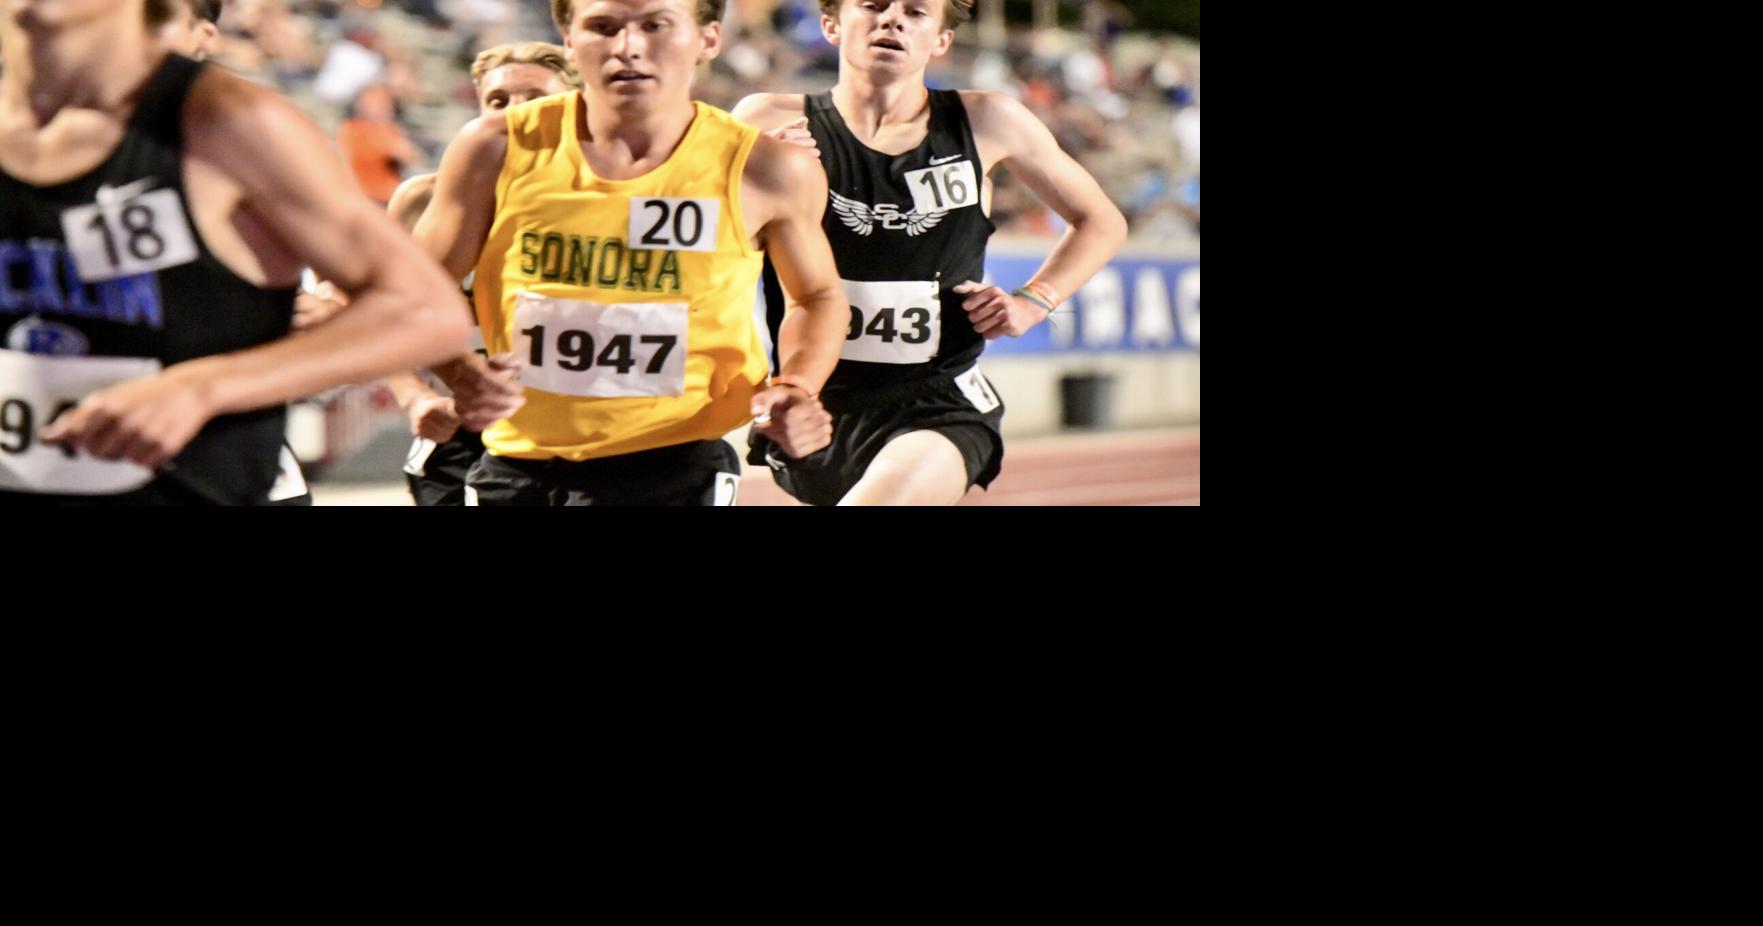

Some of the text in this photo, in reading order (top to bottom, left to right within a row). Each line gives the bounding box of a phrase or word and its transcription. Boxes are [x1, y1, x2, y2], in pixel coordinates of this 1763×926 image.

[920, 166, 968, 208] 16
[87, 203, 165, 268] 18
[641, 199, 704, 247] 20
[520, 231, 682, 294] SONORA
[521, 324, 678, 375] 1947
